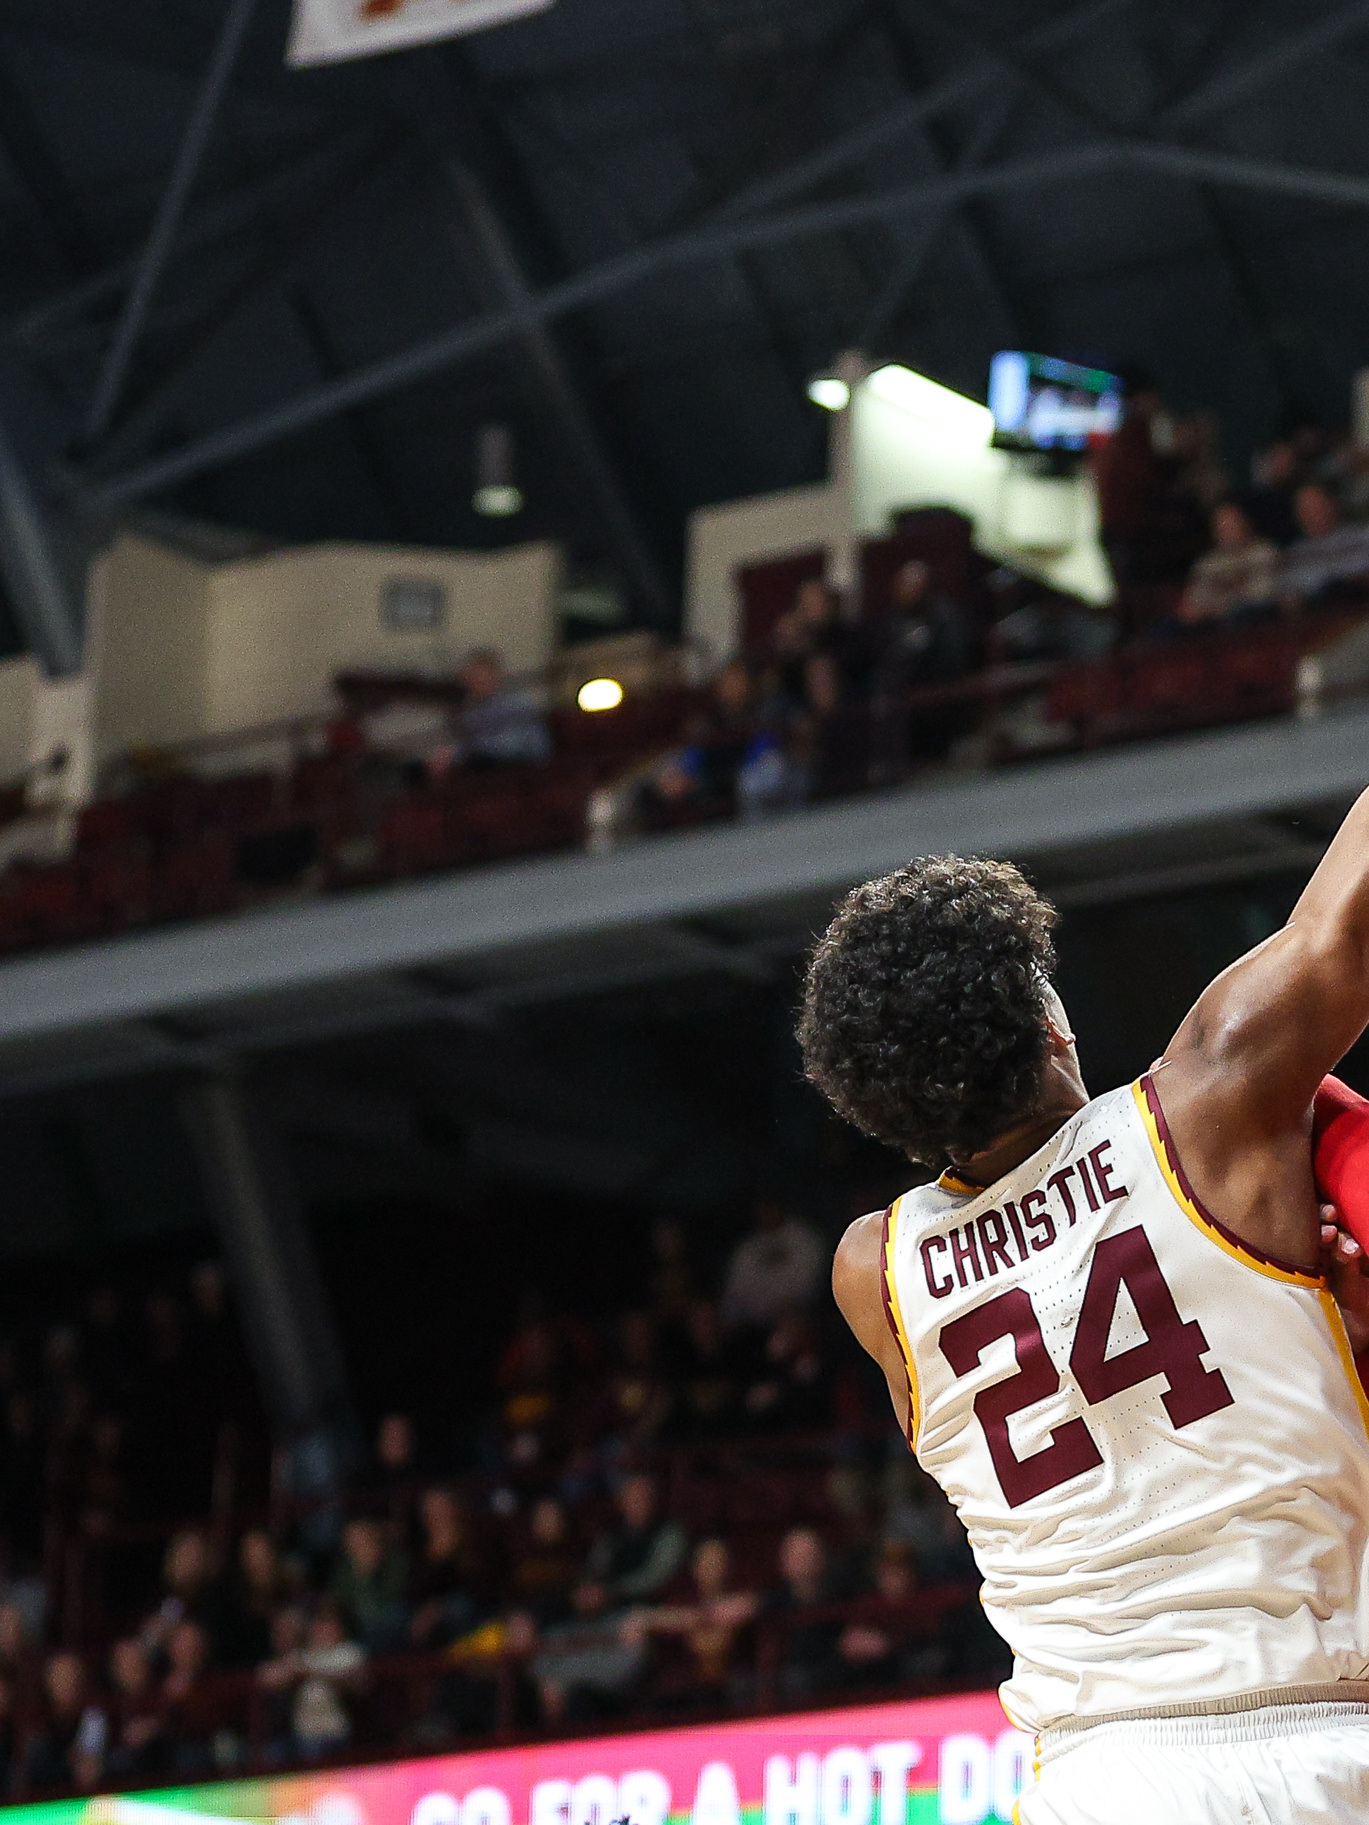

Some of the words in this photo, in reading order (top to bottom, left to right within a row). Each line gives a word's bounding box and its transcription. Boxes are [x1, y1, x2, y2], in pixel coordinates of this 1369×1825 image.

[920, 1139, 1129, 1299] CHRISTIE
[939, 1224, 1235, 1509] 24
[692, 1760, 741, 1825] A
[764, 1740, 923, 1825] HOT
[939, 1727, 1037, 1824] DO
